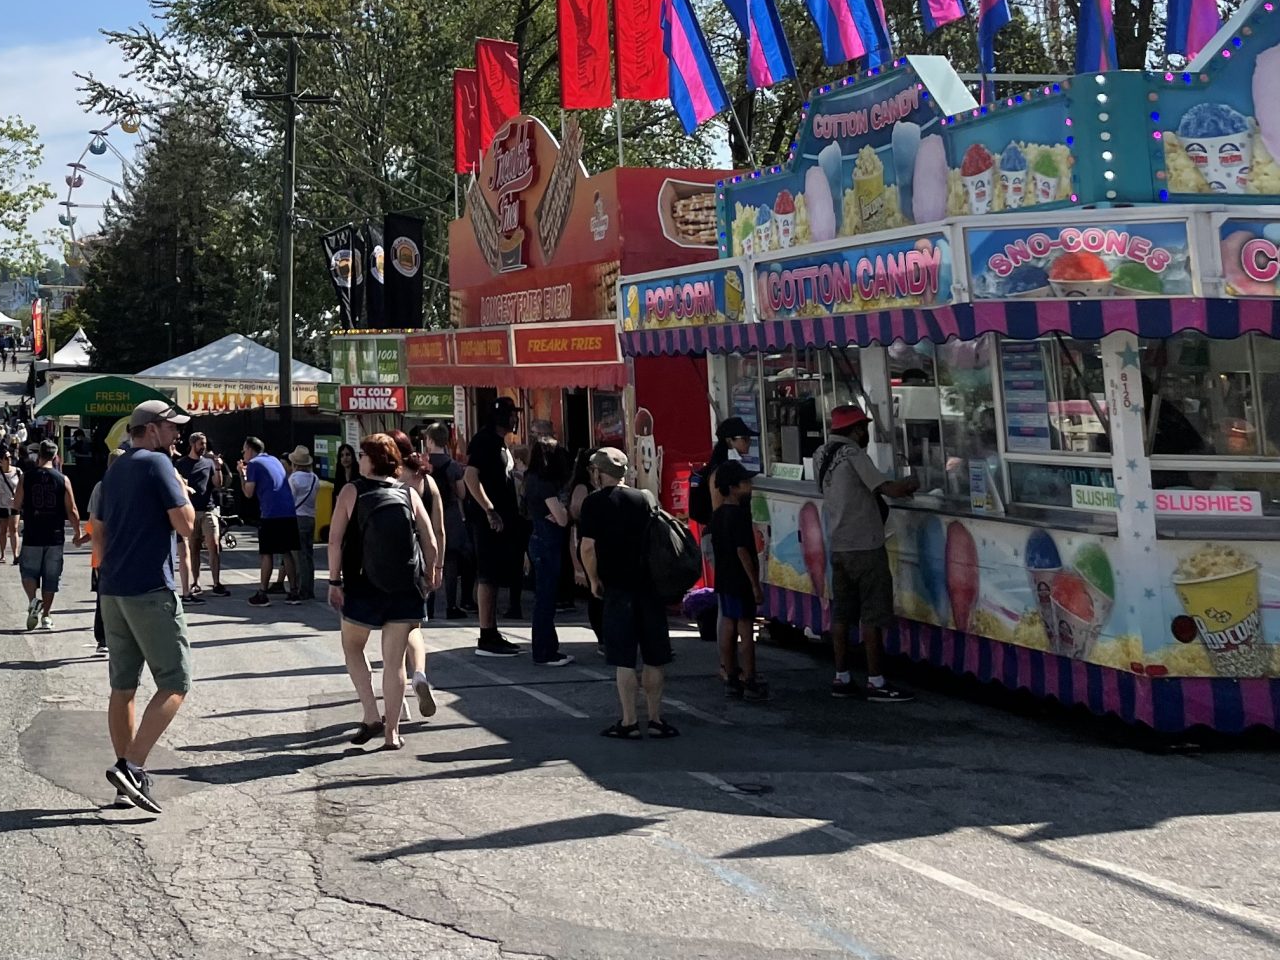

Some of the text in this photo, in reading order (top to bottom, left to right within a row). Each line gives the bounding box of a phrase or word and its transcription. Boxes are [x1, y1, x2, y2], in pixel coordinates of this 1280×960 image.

[812, 83, 919, 139] COTTON CANDY
[988, 228, 1171, 277] SNO-CONES
[768, 246, 941, 312] COTTON CANDY
[480, 283, 572, 326] LONGEST FRIES EVER!
[645, 280, 717, 323] POPCORN
[571, 337, 602, 351] FRIES
[377, 350, 397, 360] 100%
[240, 383, 272, 391] ORIGINAL
[353, 388, 392, 397] ICE COLD
[1121, 373, 1131, 408] 8120
[95, 392, 130, 401] FRESH
[349, 397, 398, 410] DRINKS
[414, 395, 439, 406] 100%
[85, 402, 136, 413] LEMONAD
[1155, 494, 1253, 512] SLUSHIES
